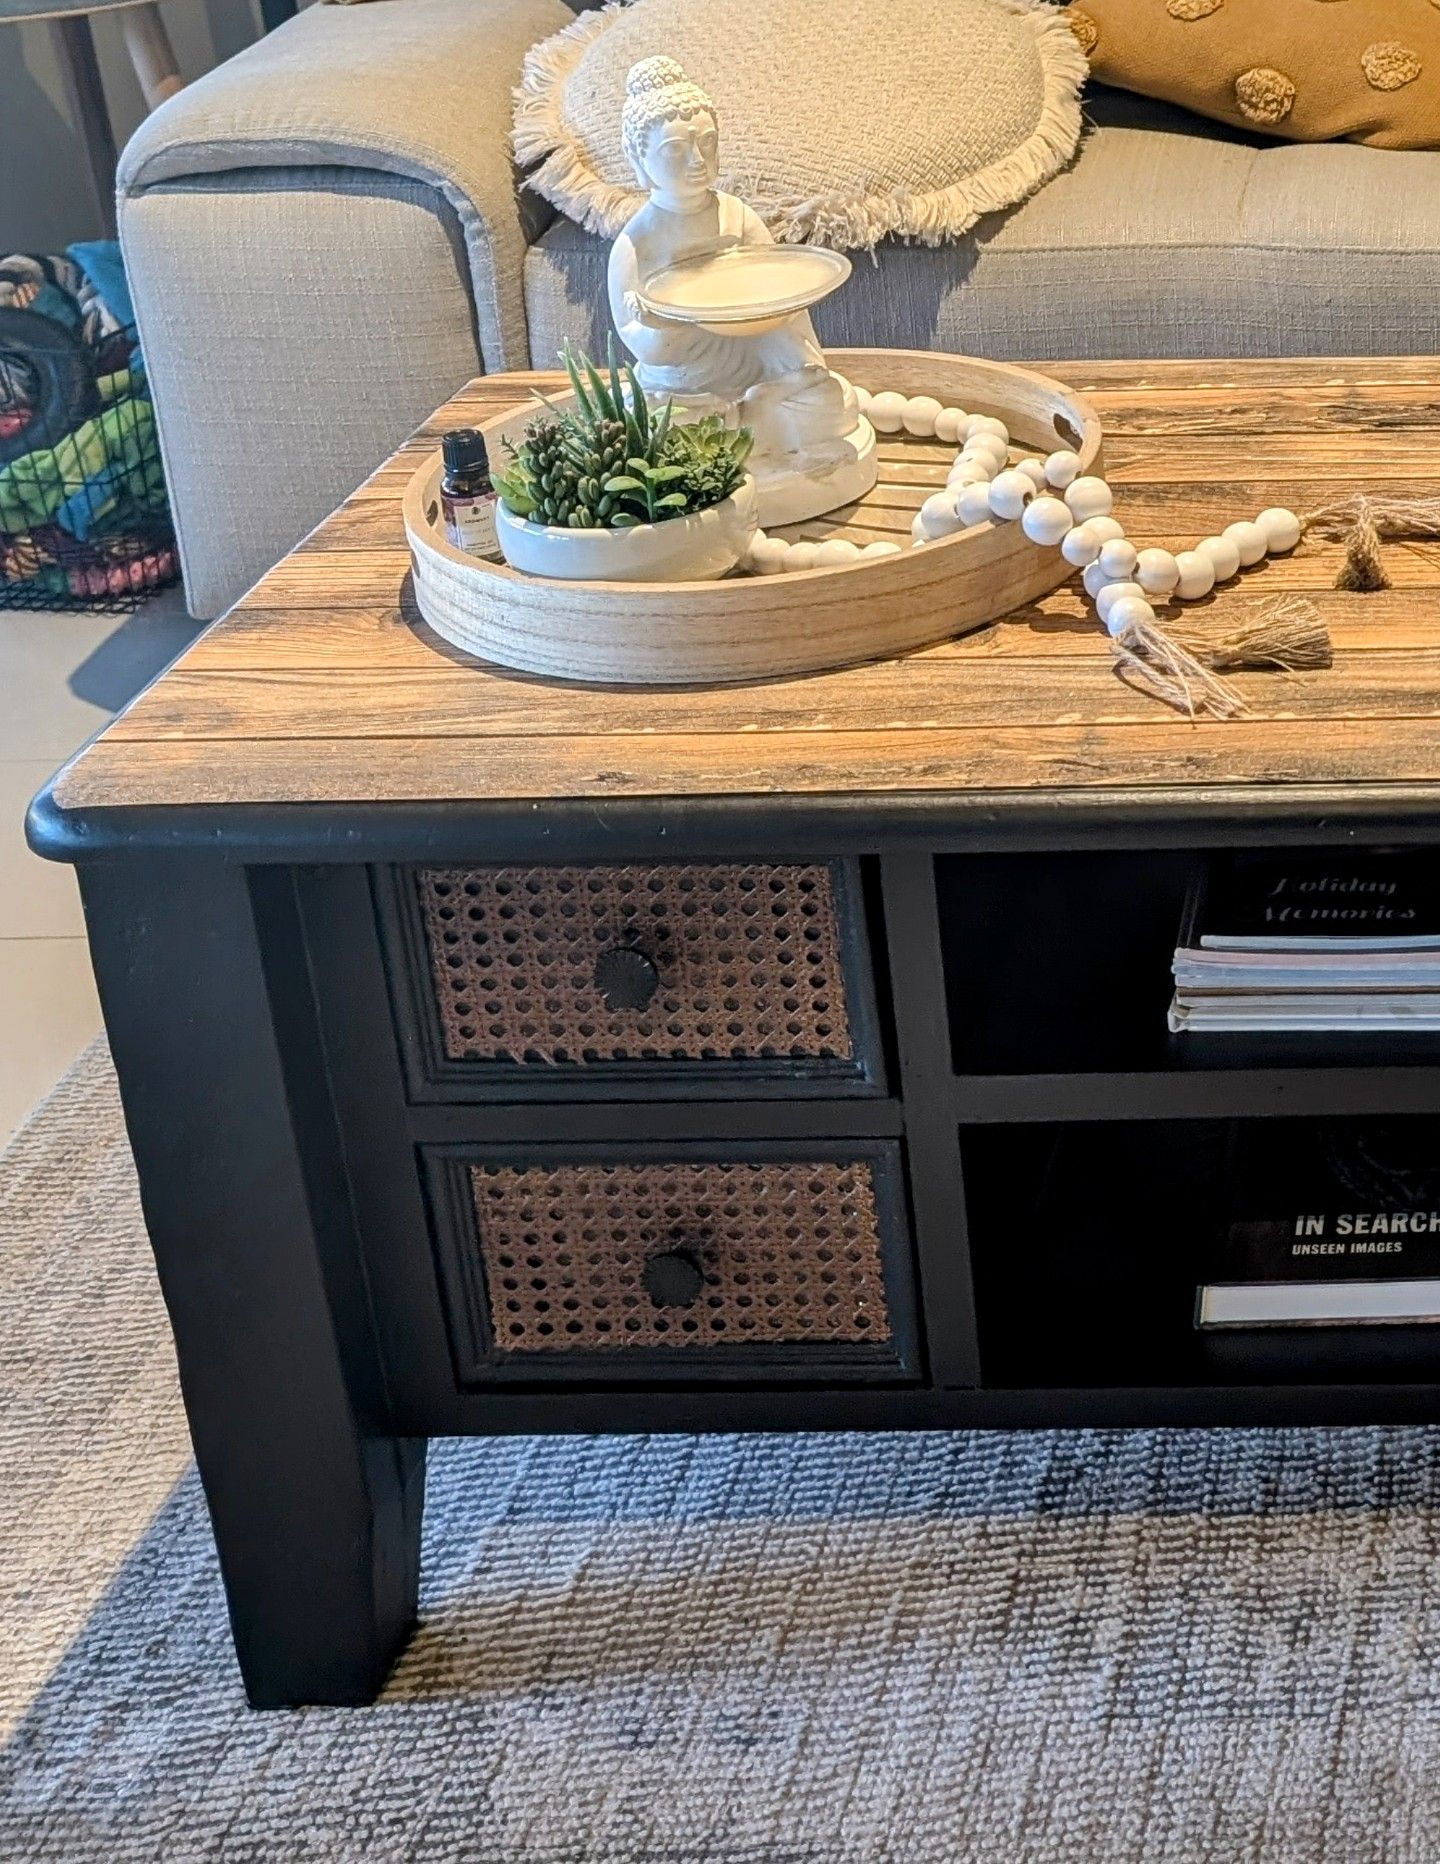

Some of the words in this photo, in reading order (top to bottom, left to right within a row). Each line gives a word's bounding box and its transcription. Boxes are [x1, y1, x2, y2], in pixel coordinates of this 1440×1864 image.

[1264, 904, 1418, 922] Memories
[1294, 1214, 1326, 1236] IN
[1290, 1243, 1347, 1256] UNSEEN
[1349, 1241, 1403, 1254] IMAGES
